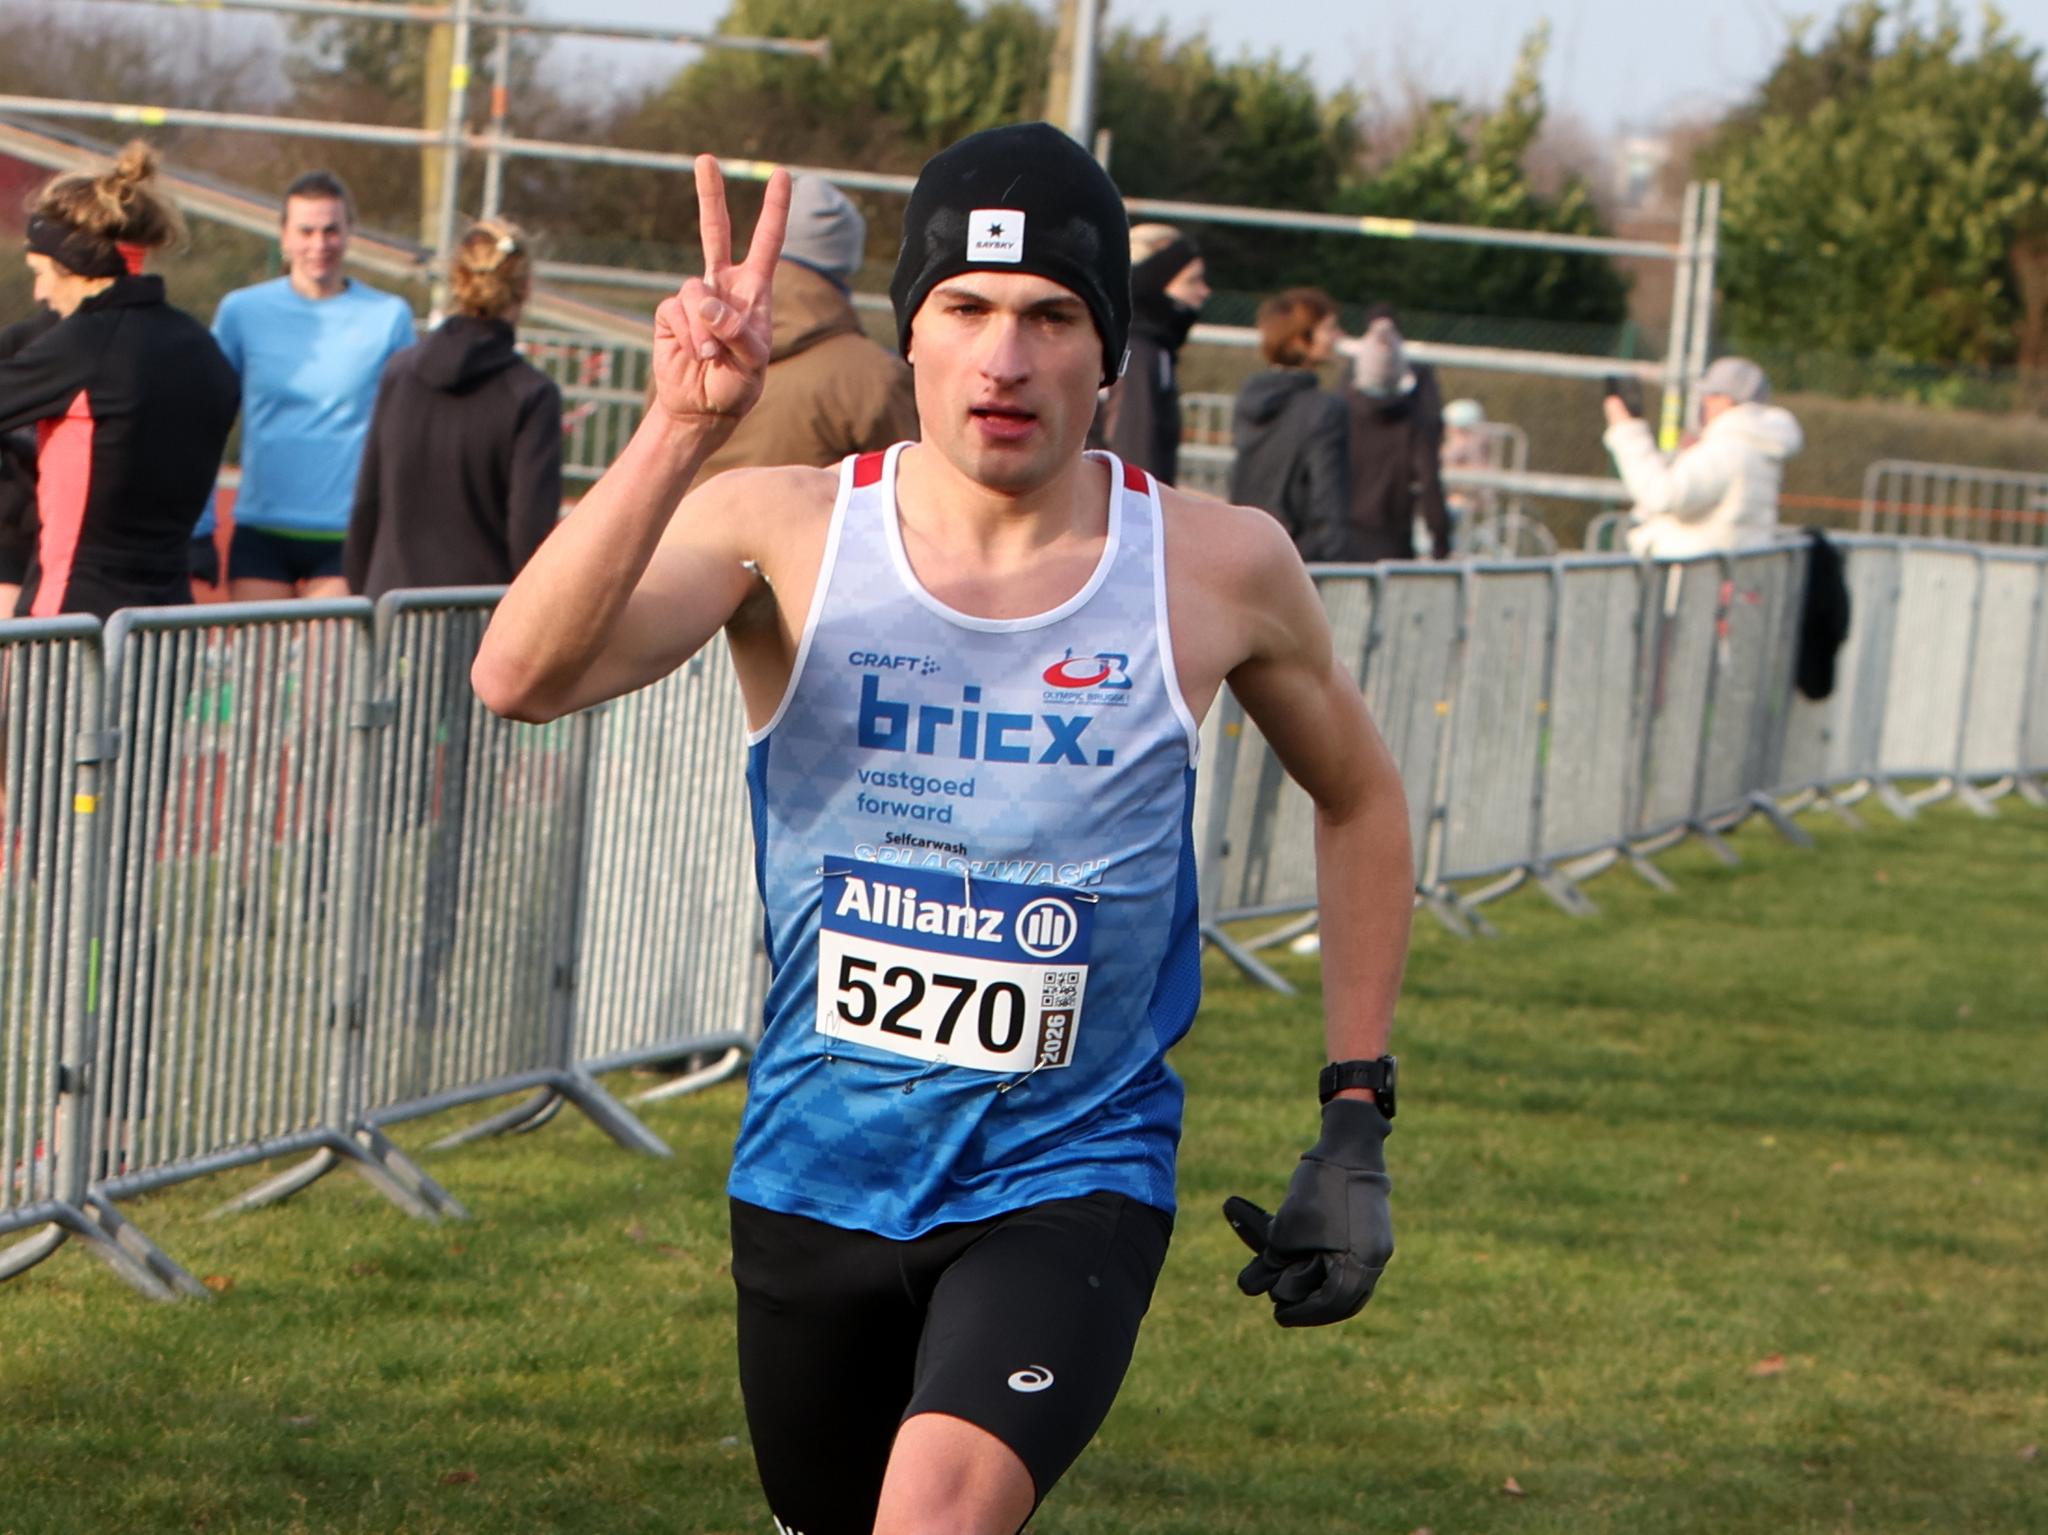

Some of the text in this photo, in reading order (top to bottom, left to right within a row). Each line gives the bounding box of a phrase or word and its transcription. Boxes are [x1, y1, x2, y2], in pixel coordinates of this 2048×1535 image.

[976, 241, 1015, 249] SAYSKY
[849, 651, 921, 672] CRAFT
[857, 768, 975, 798] vastgoed
[857, 793, 953, 824] forward
[885, 831, 967, 856] Selfcarwash
[835, 876, 1006, 942] Allianz
[836, 954, 1026, 1055] 5270
[1040, 1014, 1066, 1063] 2026
